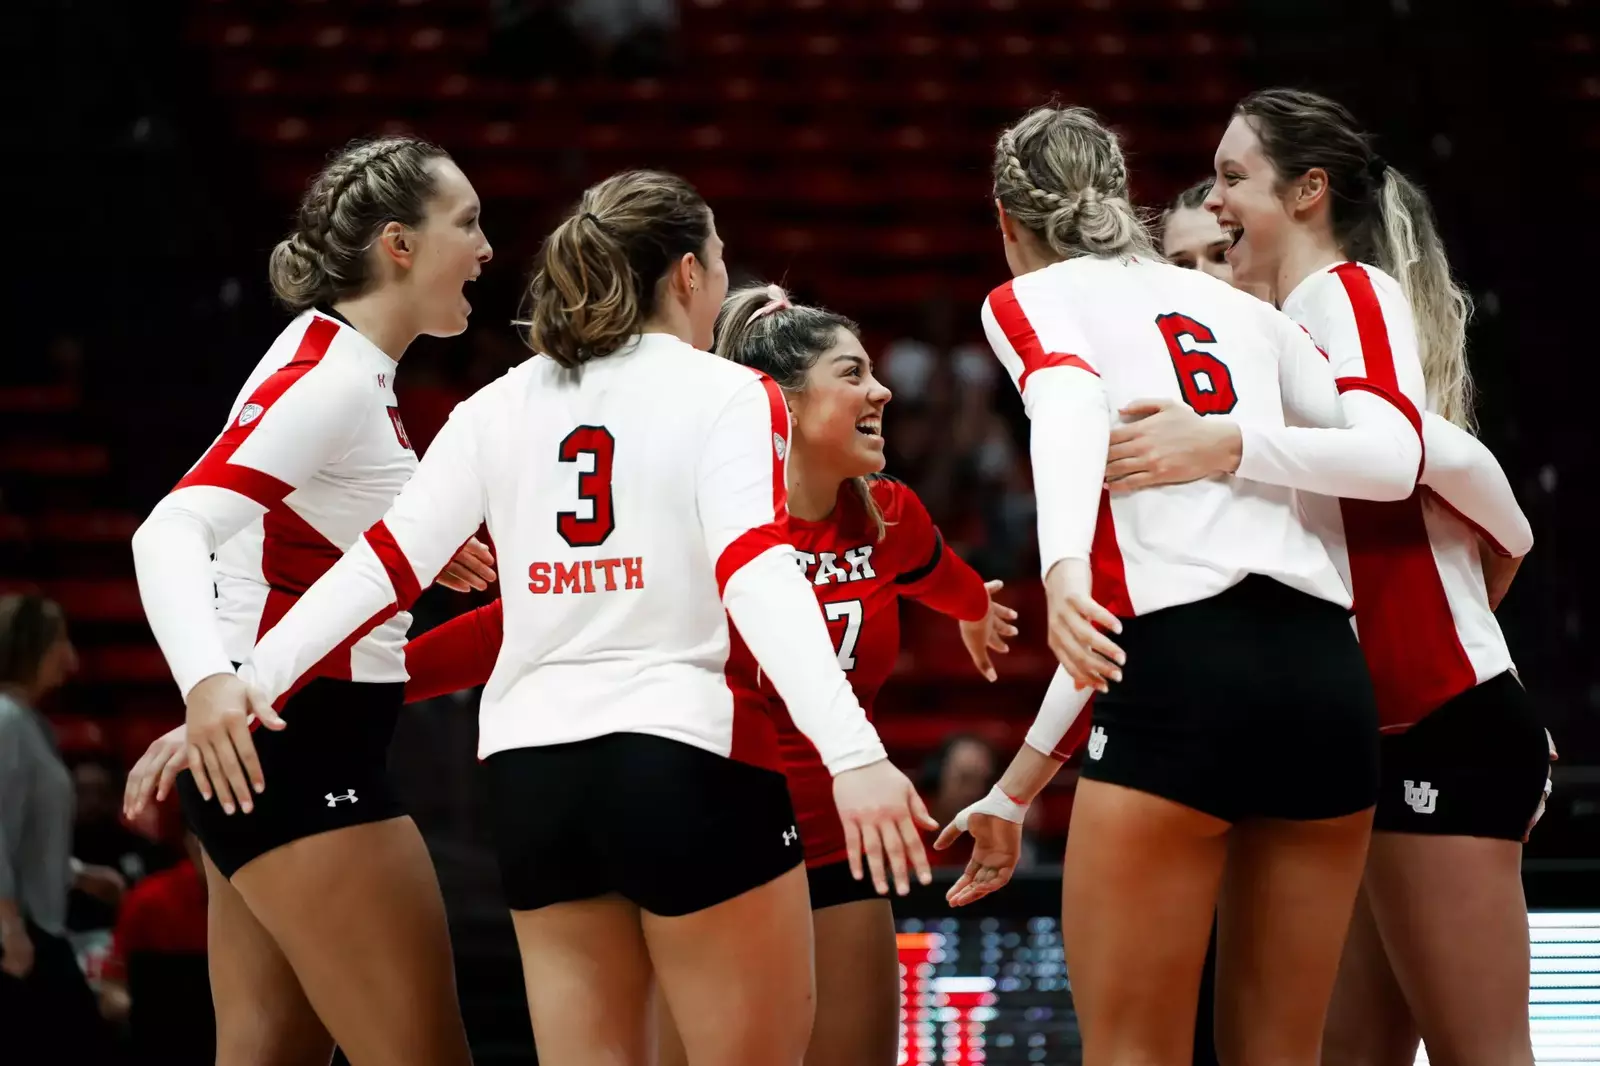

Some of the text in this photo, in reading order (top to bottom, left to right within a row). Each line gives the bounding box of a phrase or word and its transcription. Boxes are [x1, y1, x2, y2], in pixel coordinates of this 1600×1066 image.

[1155, 312, 1238, 417] 6
[557, 425, 615, 547] 3
[528, 557, 645, 594] SMITH
[795, 545, 877, 586] TAH
